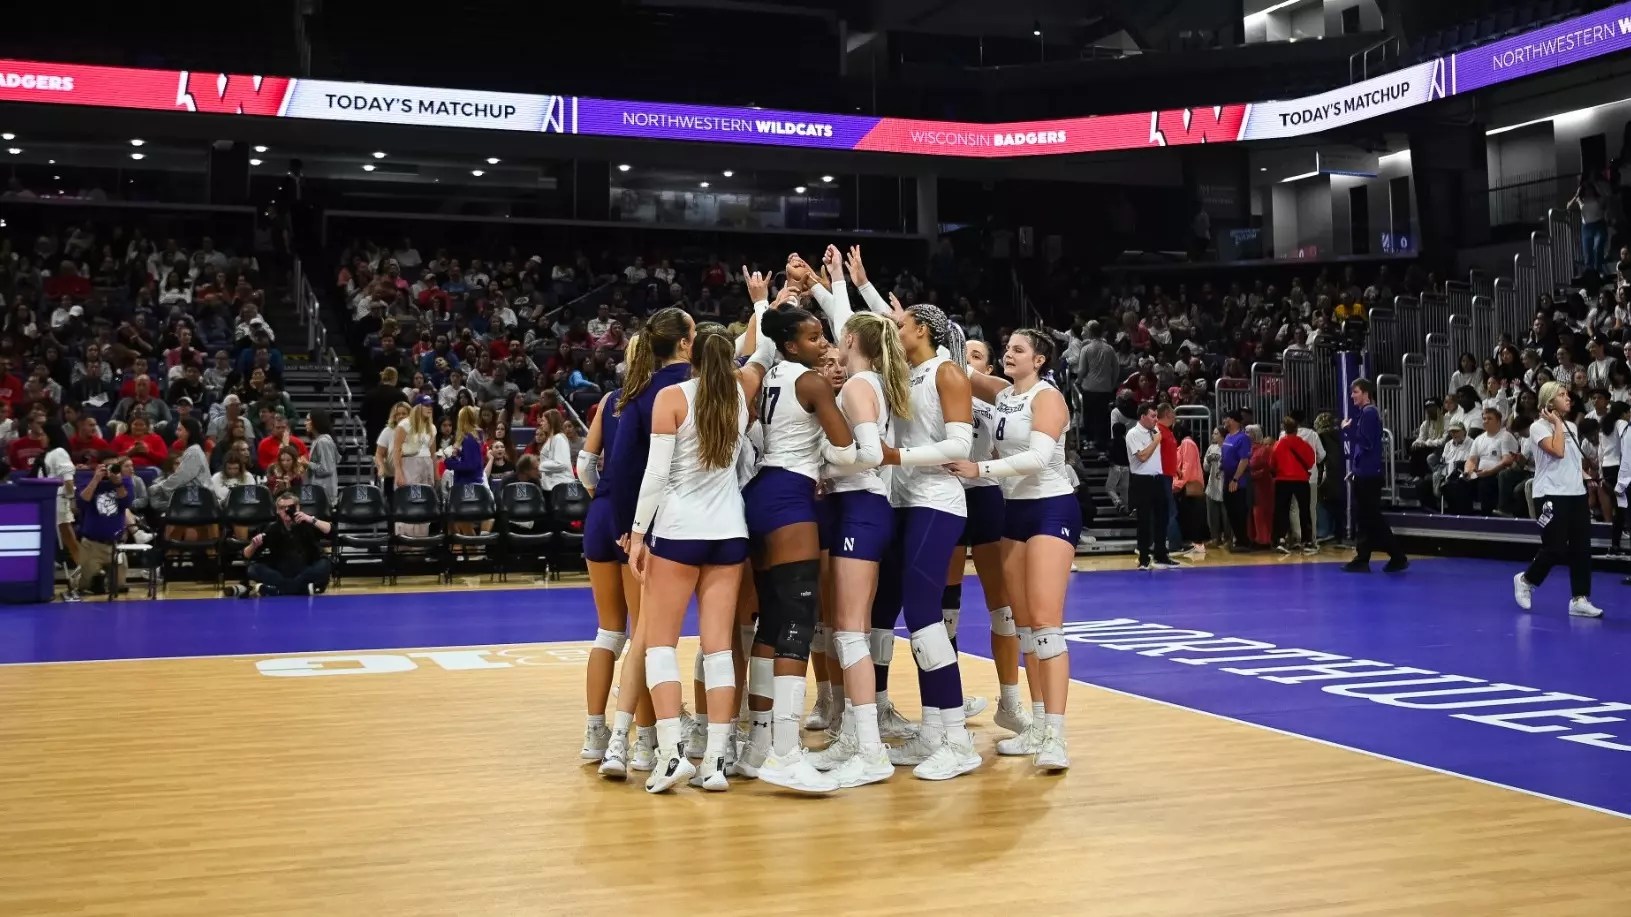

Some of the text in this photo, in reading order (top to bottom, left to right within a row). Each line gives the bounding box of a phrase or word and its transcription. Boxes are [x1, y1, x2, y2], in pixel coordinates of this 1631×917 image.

[1493, 21, 1615, 71] NORTHWESTERN
[325, 94, 516, 119] TODAY'S MATCHUP
[1278, 81, 1410, 126] TODAY'S MATCHUP
[622, 112, 833, 137] NORTHWESTERN WILDCATS
[910, 130, 1067, 147] WISCONSIN BADGERS
[761, 386, 781, 425] 17
[995, 417, 1006, 441] 8
[844, 537, 855, 552] N
